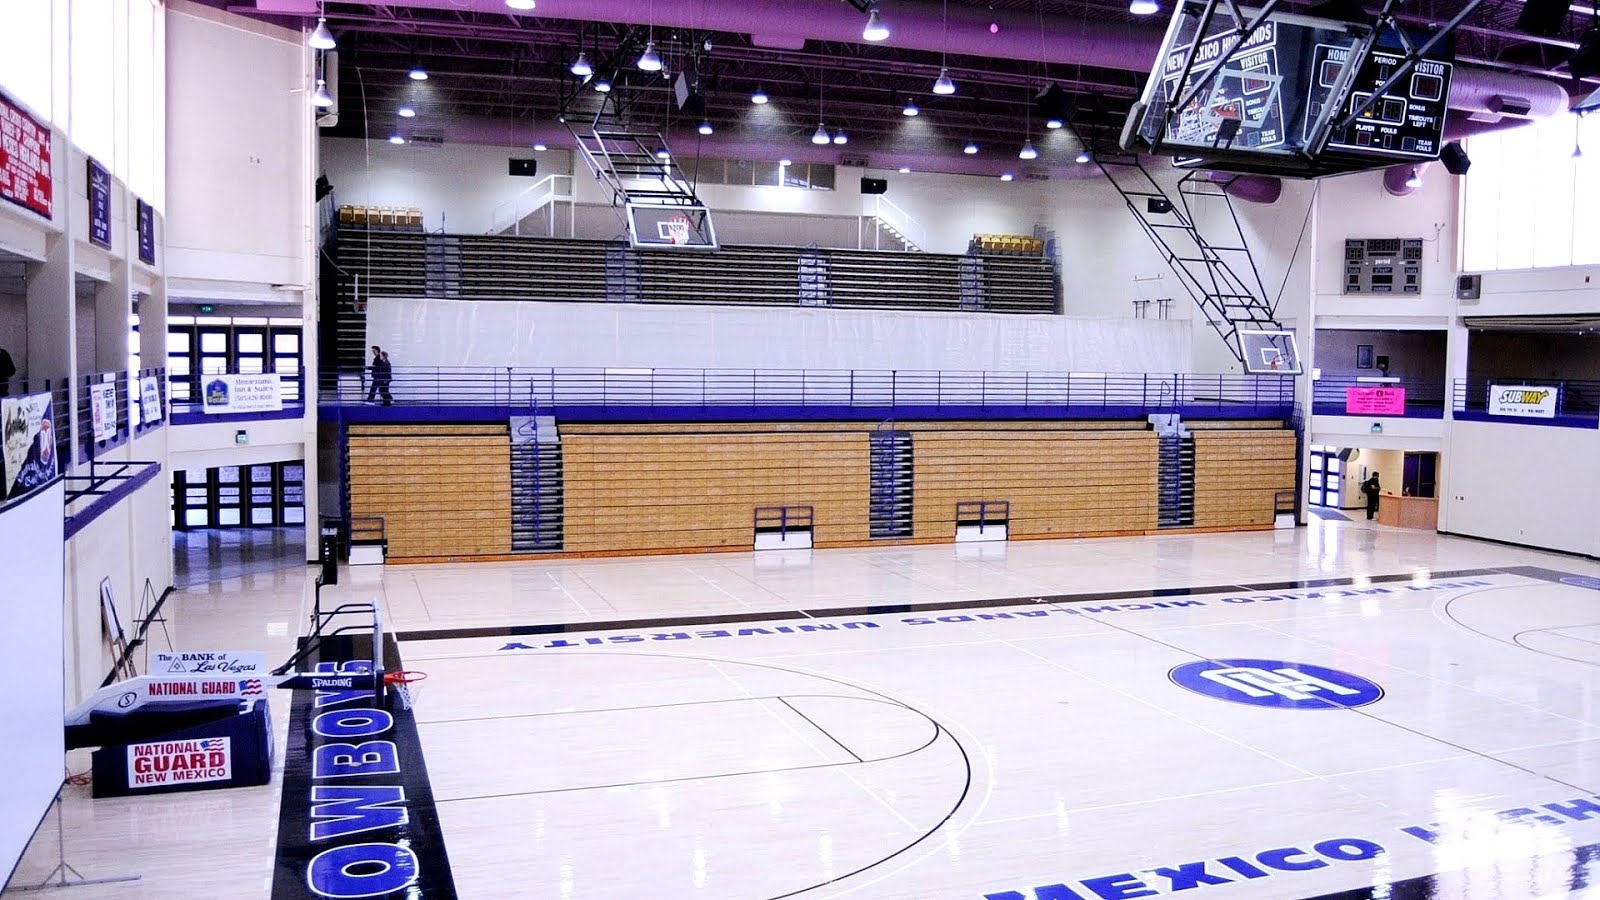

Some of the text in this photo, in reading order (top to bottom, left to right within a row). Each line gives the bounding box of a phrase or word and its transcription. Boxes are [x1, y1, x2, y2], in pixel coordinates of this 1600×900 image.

[1240, 51, 1268, 69] VISITOR
[1327, 48, 1350, 60] HOM
[1374, 56, 1397, 65] PERIOD
[1166, 52, 1185, 72] NEW
[1414, 62, 1444, 75] VISITOR
[1409, 104, 1426, 112] BONUS
[1408, 114, 1434, 124] TIMEOUTS
[1261, 129, 1276, 138] TEAM
[1355, 124, 1398, 135] PLAYER FOULS
[1260, 135, 1277, 143] FOULS
[1499, 390, 1549, 404] SUBWAY
[496, 620, 882, 652] UNIVERSITY
[158, 652, 228, 662] The BANK of
[190, 659, 257, 674] Las Vegas
[149, 681, 236, 696] NATIONAL GUARD
[311, 677, 353, 688] SPALDING
[134, 742, 200, 757] NATIONAL
[134, 752, 225, 774] GUARD
[135, 768, 226, 784] NEW MEXICO
